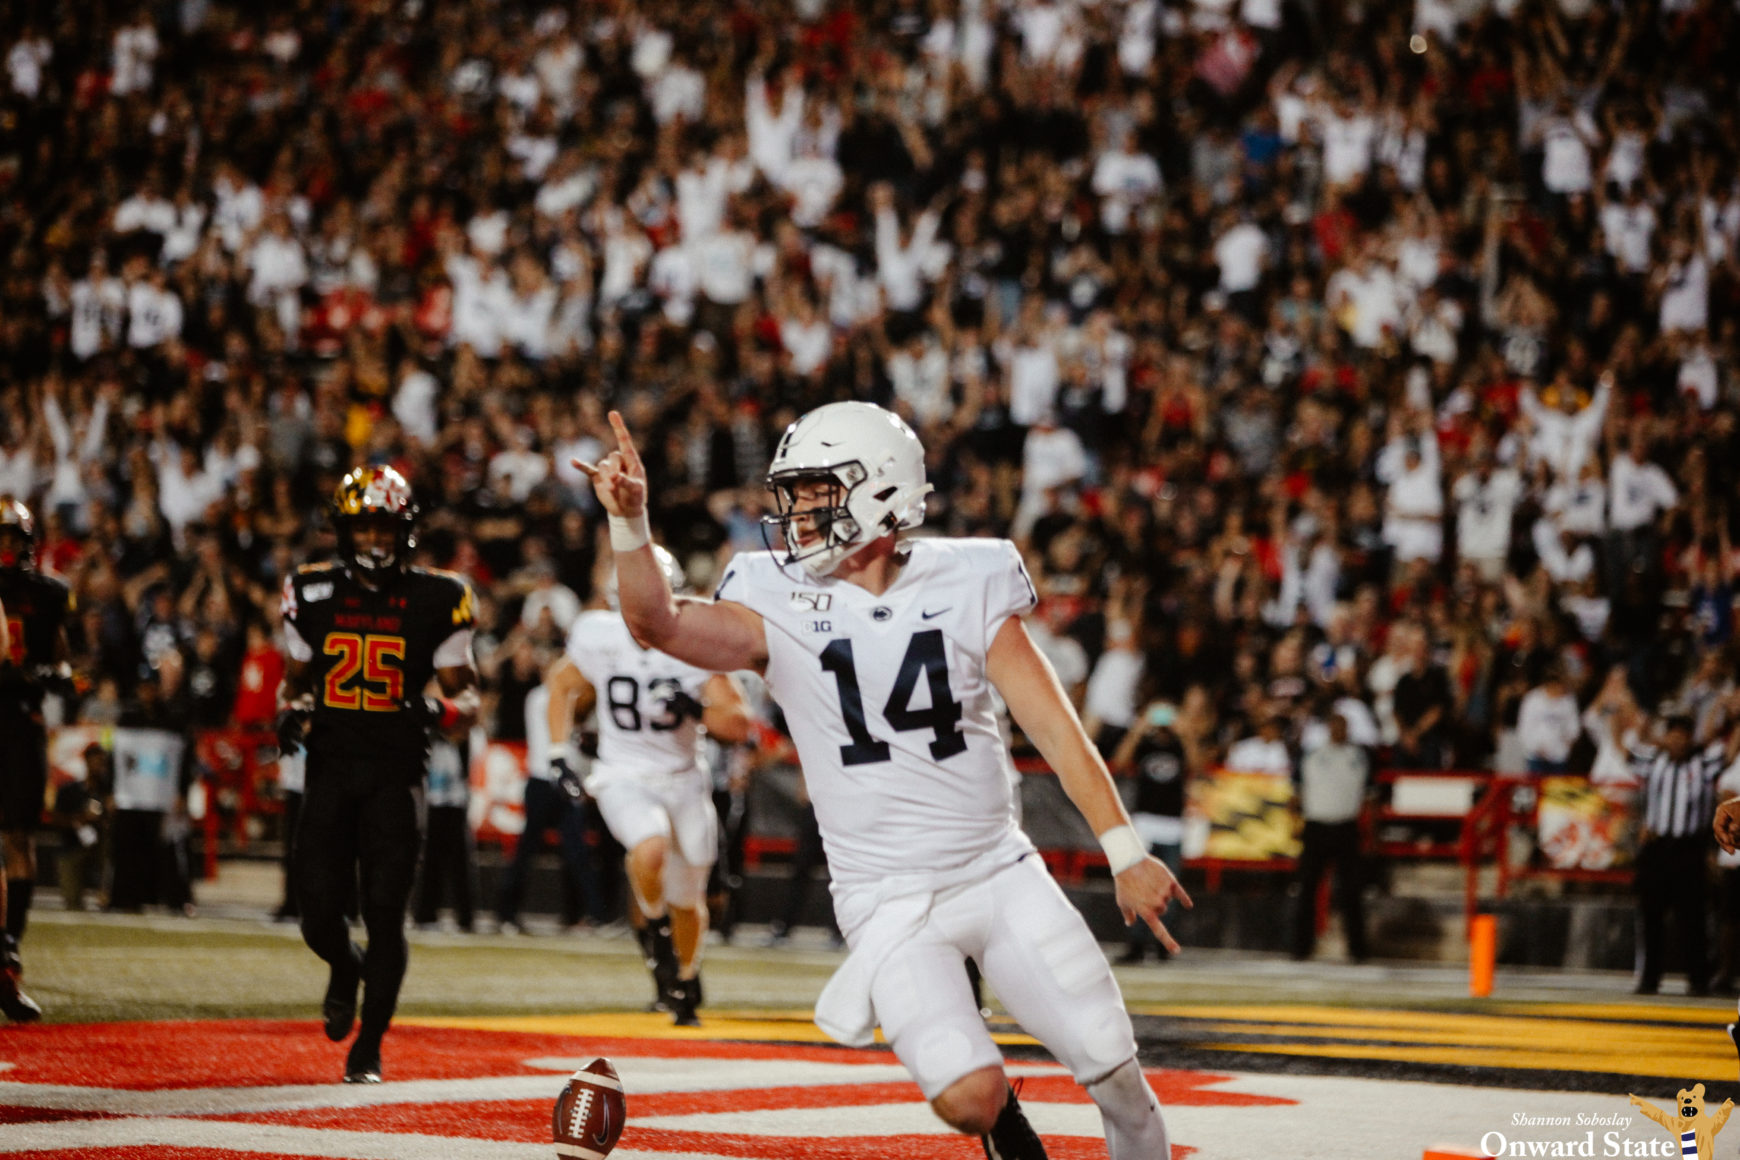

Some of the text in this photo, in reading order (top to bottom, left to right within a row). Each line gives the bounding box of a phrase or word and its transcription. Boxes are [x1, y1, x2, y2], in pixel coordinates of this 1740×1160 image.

[323, 632, 406, 712] 25
[608, 676, 684, 731] 83
[819, 629, 967, 767] 14
